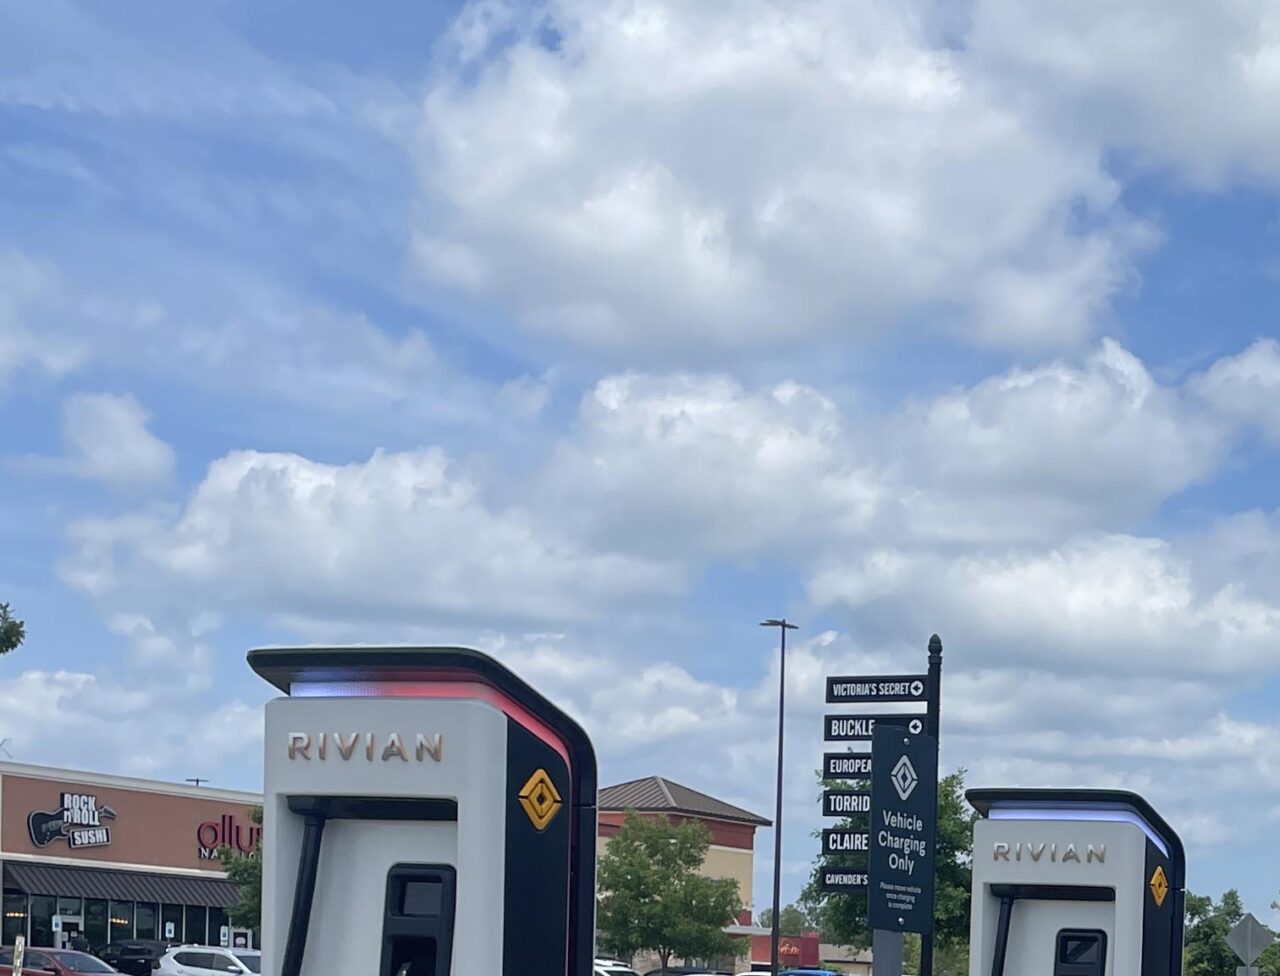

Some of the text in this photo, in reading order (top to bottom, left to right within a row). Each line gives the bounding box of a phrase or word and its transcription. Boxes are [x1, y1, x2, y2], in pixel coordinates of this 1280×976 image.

[832, 682, 910, 696] VICTORIA'S SECRET
[831, 719, 876, 736] BUCKLE
[287, 731, 443, 762] RIVIAN
[829, 759, 872, 773] EUROPEA
[63, 793, 96, 810] ROCK
[829, 795, 870, 812] TORRID
[882, 809, 923, 831] Vehicle
[74, 828, 108, 845] SUSHI
[828, 833, 869, 850] CLAIRE
[878, 830, 926, 857] Charging
[993, 841, 1105, 863] RIVIAN
[888, 853, 915, 876] Only
[825, 873, 869, 885] CAVENDER'S
